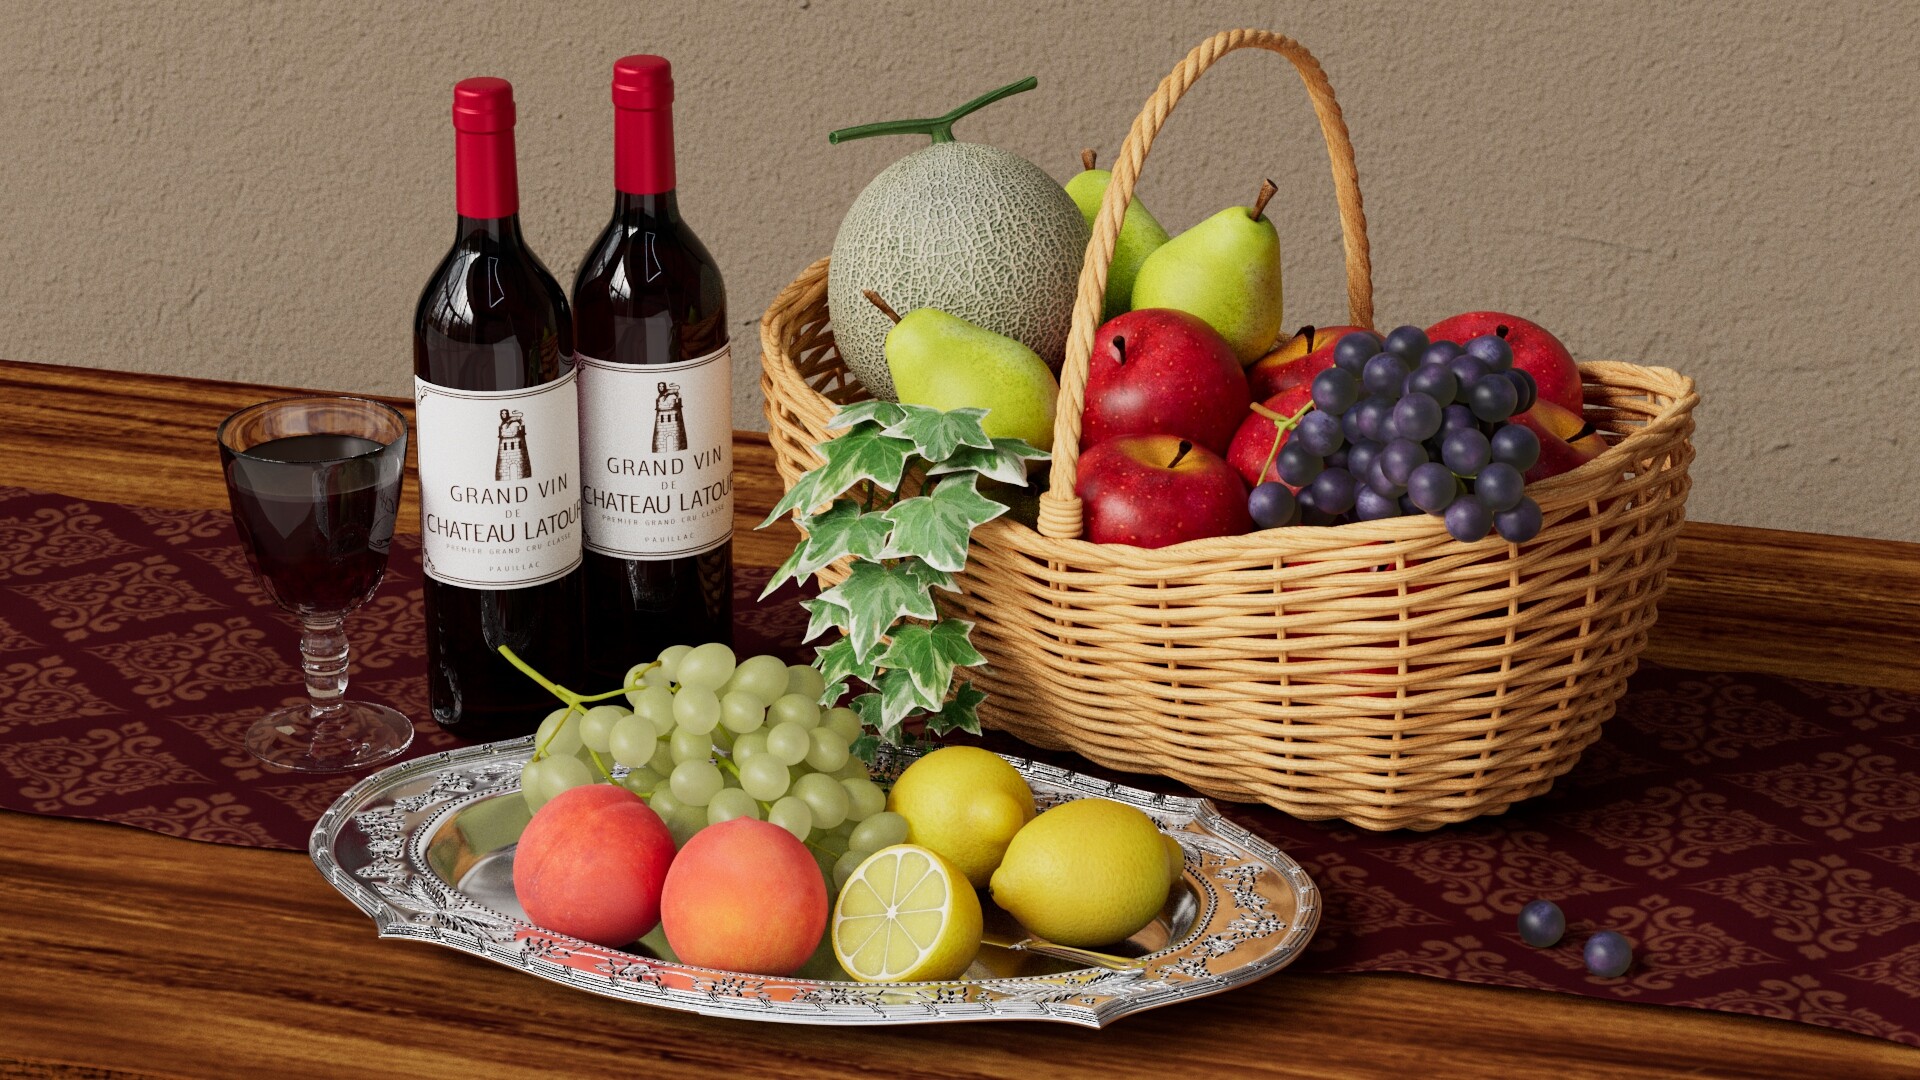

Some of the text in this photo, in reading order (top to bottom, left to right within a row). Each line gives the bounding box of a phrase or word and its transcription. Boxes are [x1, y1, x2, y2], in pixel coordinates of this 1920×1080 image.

[607, 445, 721, 476] GRAND VIN
[450, 472, 567, 504] GRAND VIN
[661, 480, 678, 490] DE
[582, 485, 671, 514] CHATEAU
[505, 509, 521, 519] DE
[602, 514, 638, 526] PREMIER
[645, 518, 676, 526] GRAND
[681, 514, 698, 523] CRU
[427, 513, 515, 543] CHATEAU
[644, 532, 695, 543] PAUILLAC
[446, 543, 483, 555] PREMIER
[489, 547, 521, 555] GRAND
[526, 543, 542, 552] CRU
[489, 561, 541, 572] PAUILLAC
